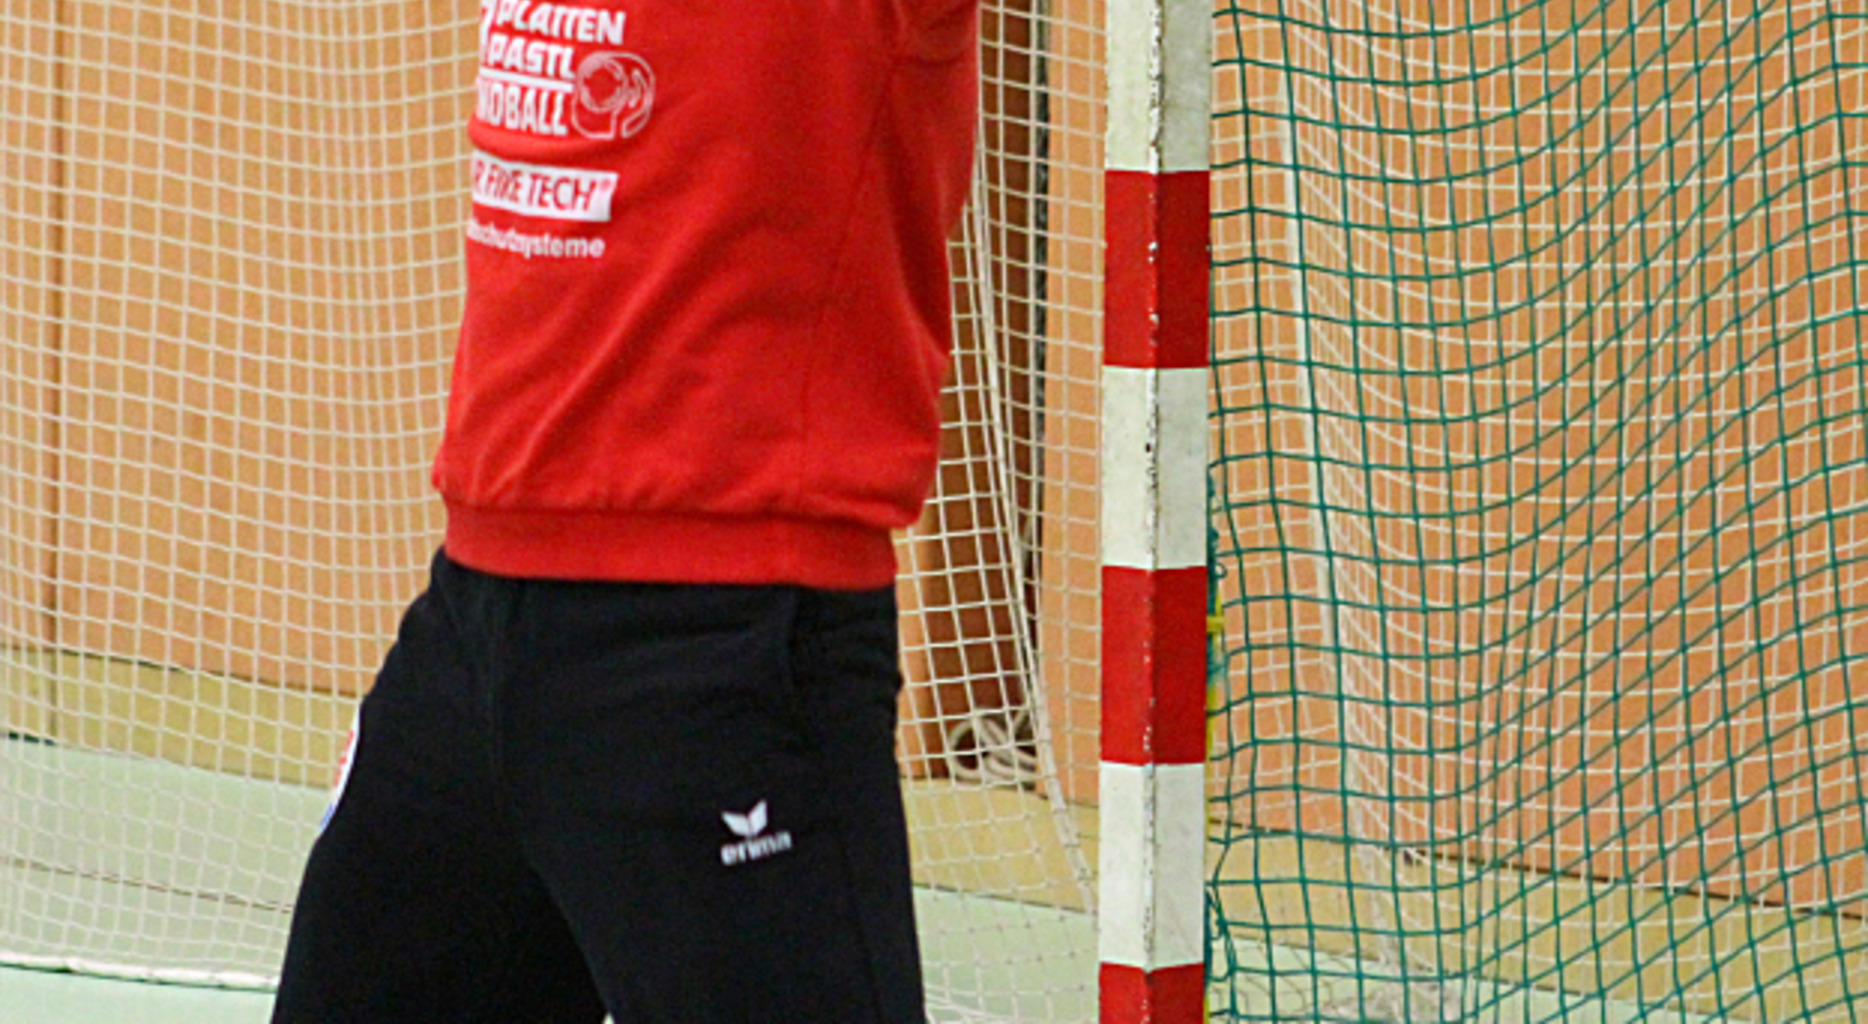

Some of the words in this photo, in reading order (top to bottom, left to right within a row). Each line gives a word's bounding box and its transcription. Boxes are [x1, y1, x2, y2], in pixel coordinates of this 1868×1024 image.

[487, 32, 576, 79] PASTL
[475, 75, 568, 136] NDBALL
[720, 830, 792, 866] erima
